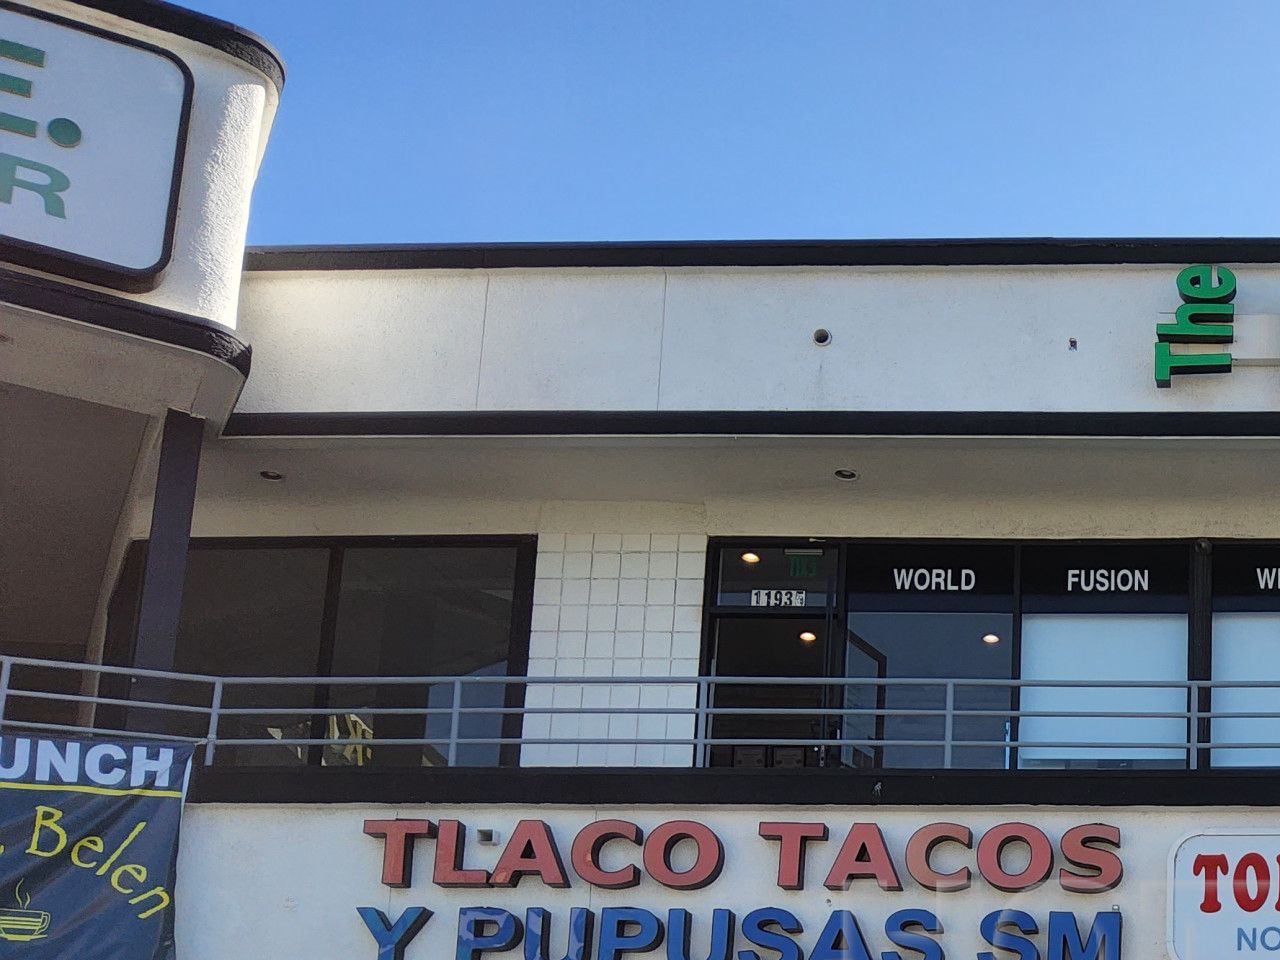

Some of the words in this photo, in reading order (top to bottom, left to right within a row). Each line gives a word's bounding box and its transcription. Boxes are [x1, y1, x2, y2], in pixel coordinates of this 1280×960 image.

[1155, 264, 1237, 388] The
[893, 568, 976, 591] WORLD
[1067, 569, 1150, 592] FUSION
[26, 806, 170, 919] Belen
[362, 820, 723, 889] TLACO
[758, 821, 1124, 894] TACOS
